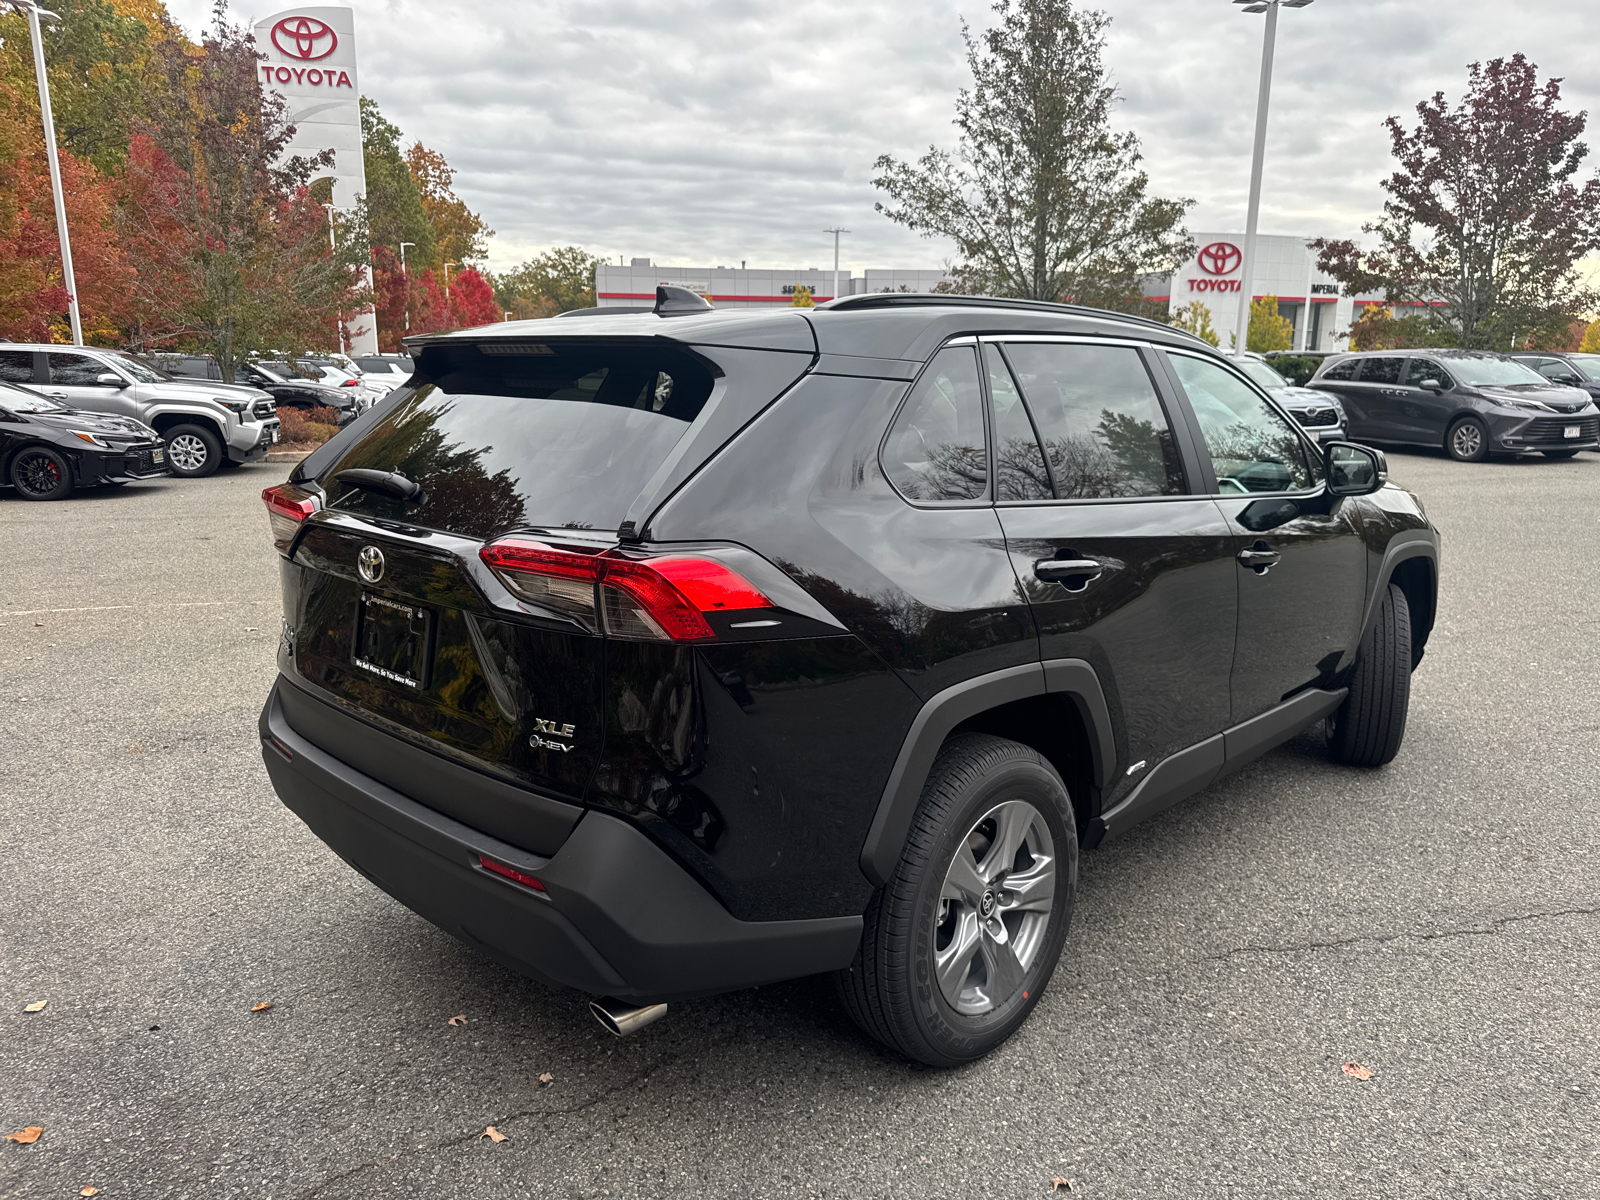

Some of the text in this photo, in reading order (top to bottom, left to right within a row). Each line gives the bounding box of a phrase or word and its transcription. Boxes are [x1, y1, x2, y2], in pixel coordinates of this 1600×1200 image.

[261, 66, 353, 88] TOYOTA
[782, 285, 816, 294] SERIE
[1311, 284, 1339, 294] IMPERIAL
[369, 665, 380, 675] More,
[380, 669, 386, 677] So
[386, 671, 394, 680] You
[394, 674, 404, 683] Save
[405, 679, 416, 688] More
[533, 717, 576, 738] XLE
[538, 738, 575, 753] HEV
[1045, 783, 1077, 863] TOYO
[926, 1012, 981, 1055] OPEN
